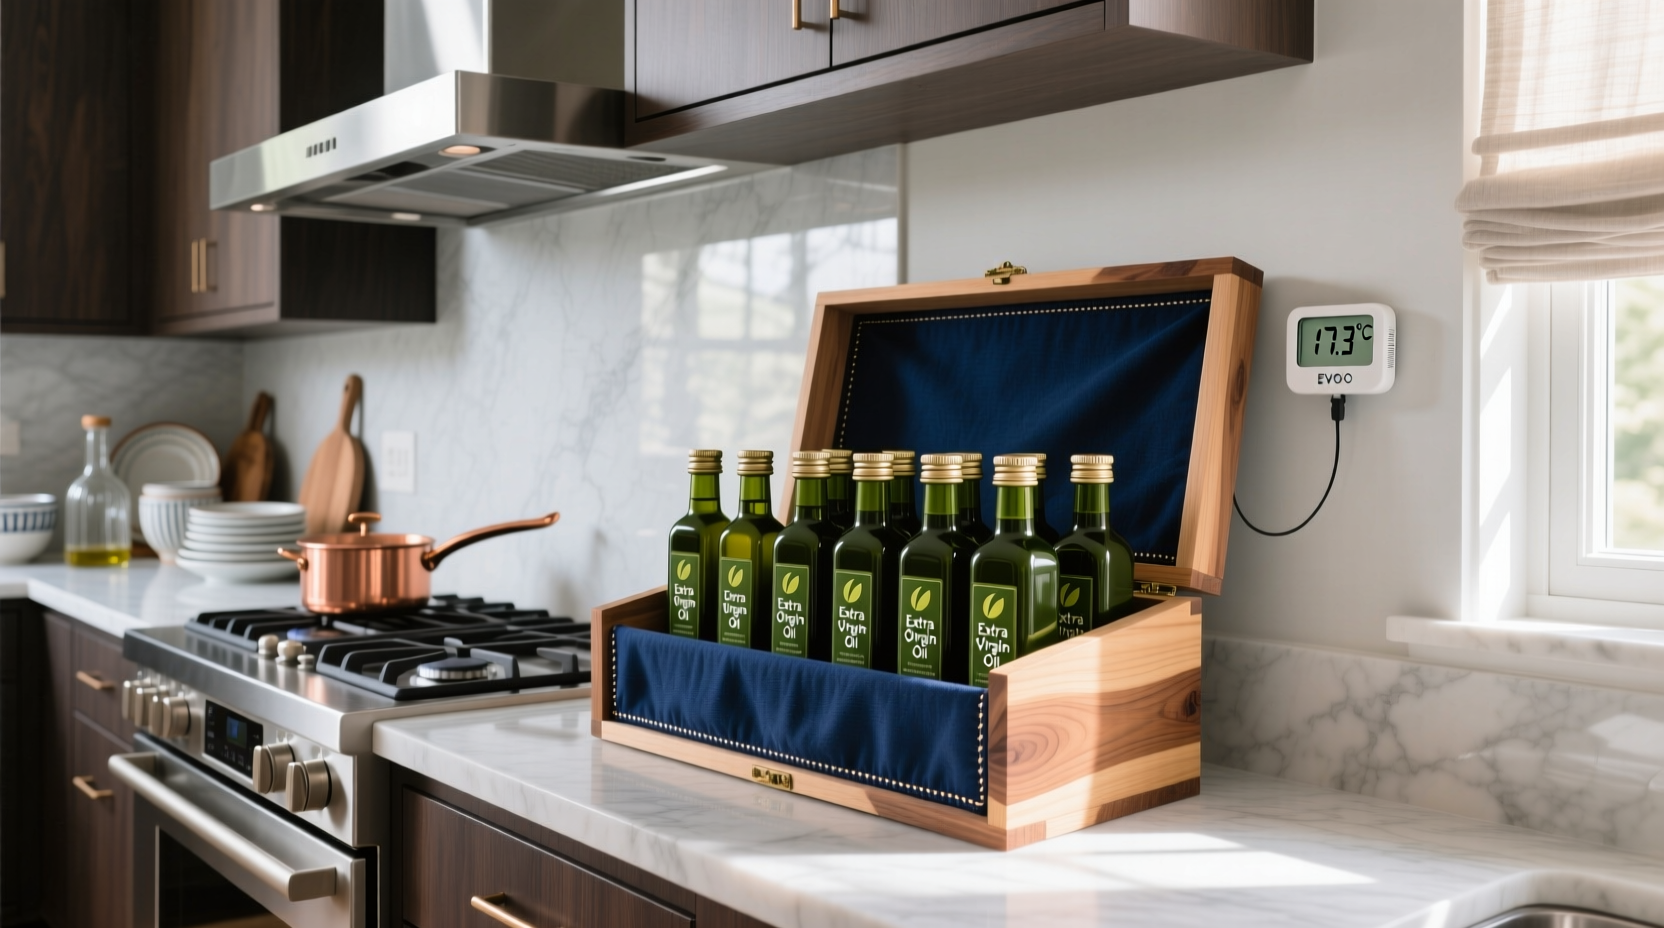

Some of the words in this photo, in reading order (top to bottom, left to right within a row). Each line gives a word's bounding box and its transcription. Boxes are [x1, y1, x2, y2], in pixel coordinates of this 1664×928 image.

[1317, 372, 1353, 385] EVOO
[838, 606, 865, 621] Extra
[906, 614, 935, 630] Extra
[978, 622, 1008, 639] Extra
[912, 644, 928, 660] Oil
